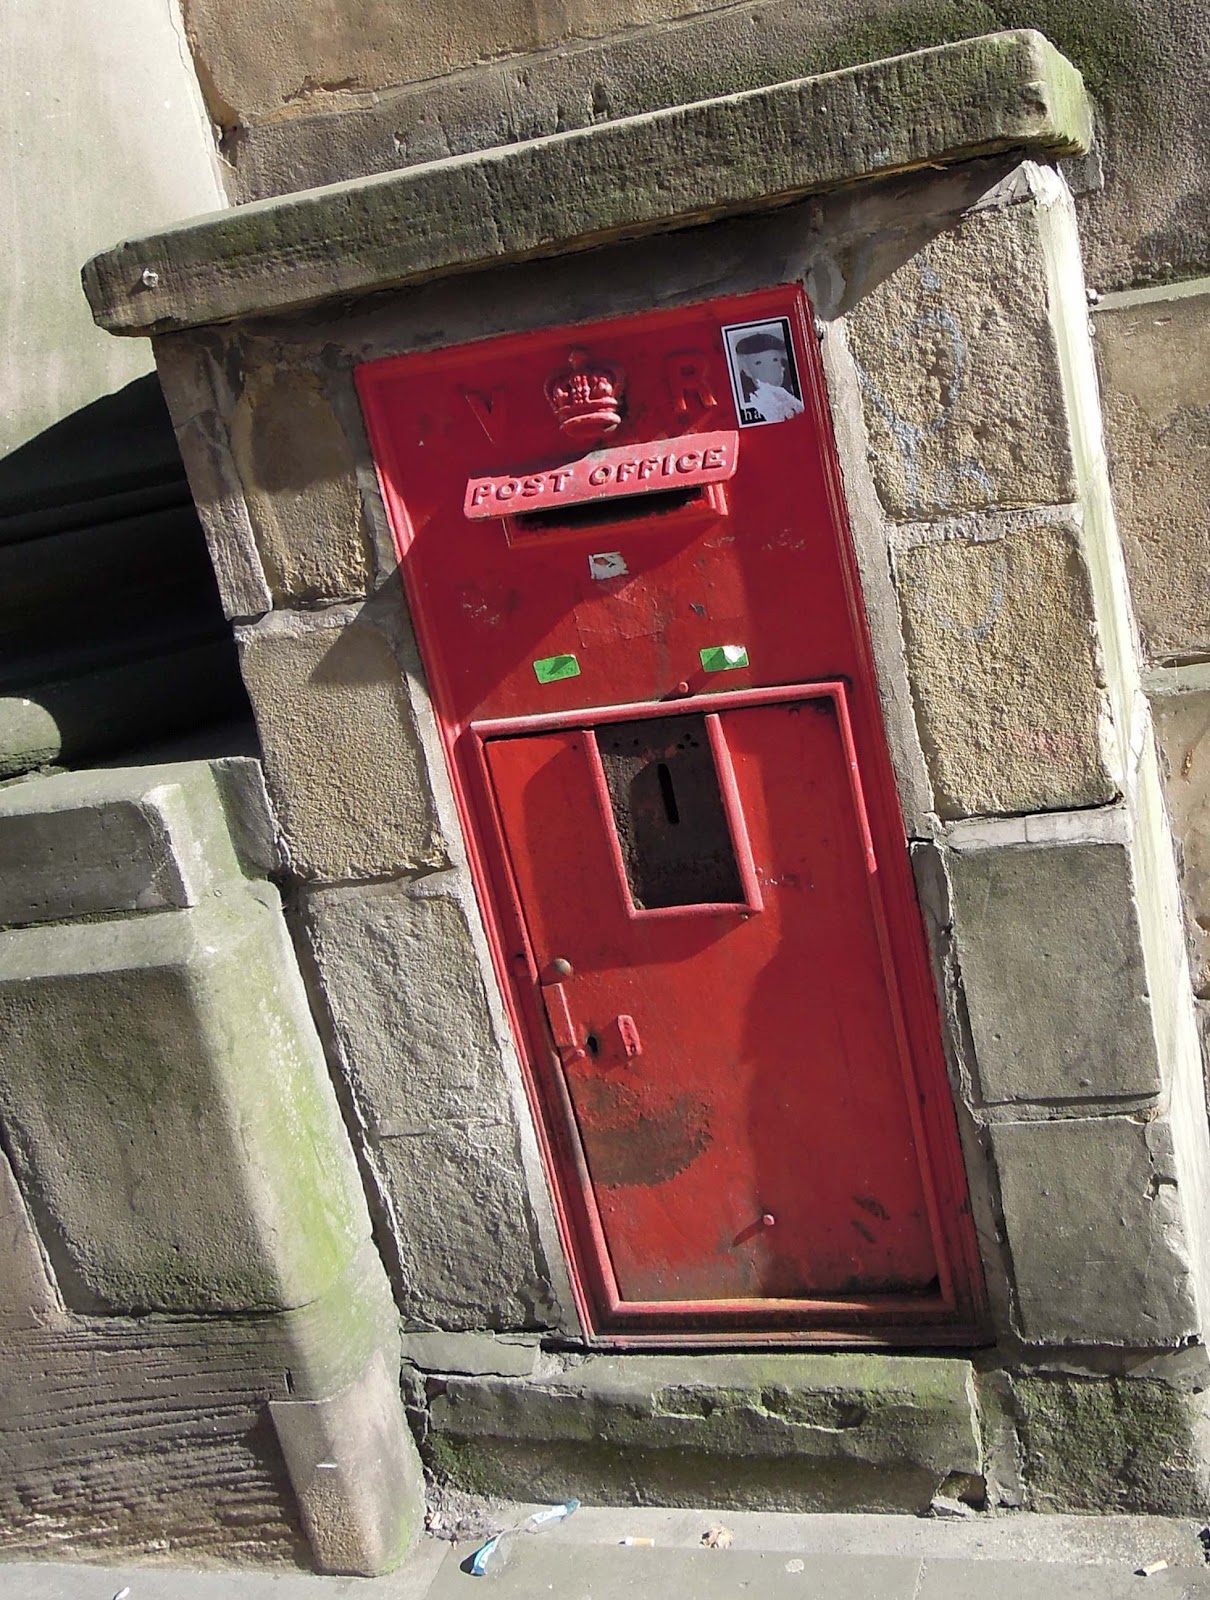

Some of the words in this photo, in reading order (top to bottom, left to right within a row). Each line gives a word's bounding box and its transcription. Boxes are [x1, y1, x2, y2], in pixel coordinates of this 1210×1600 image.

[665, 351, 719, 411] R
[471, 469, 574, 507] POST
[588, 445, 728, 487] OFFICE
